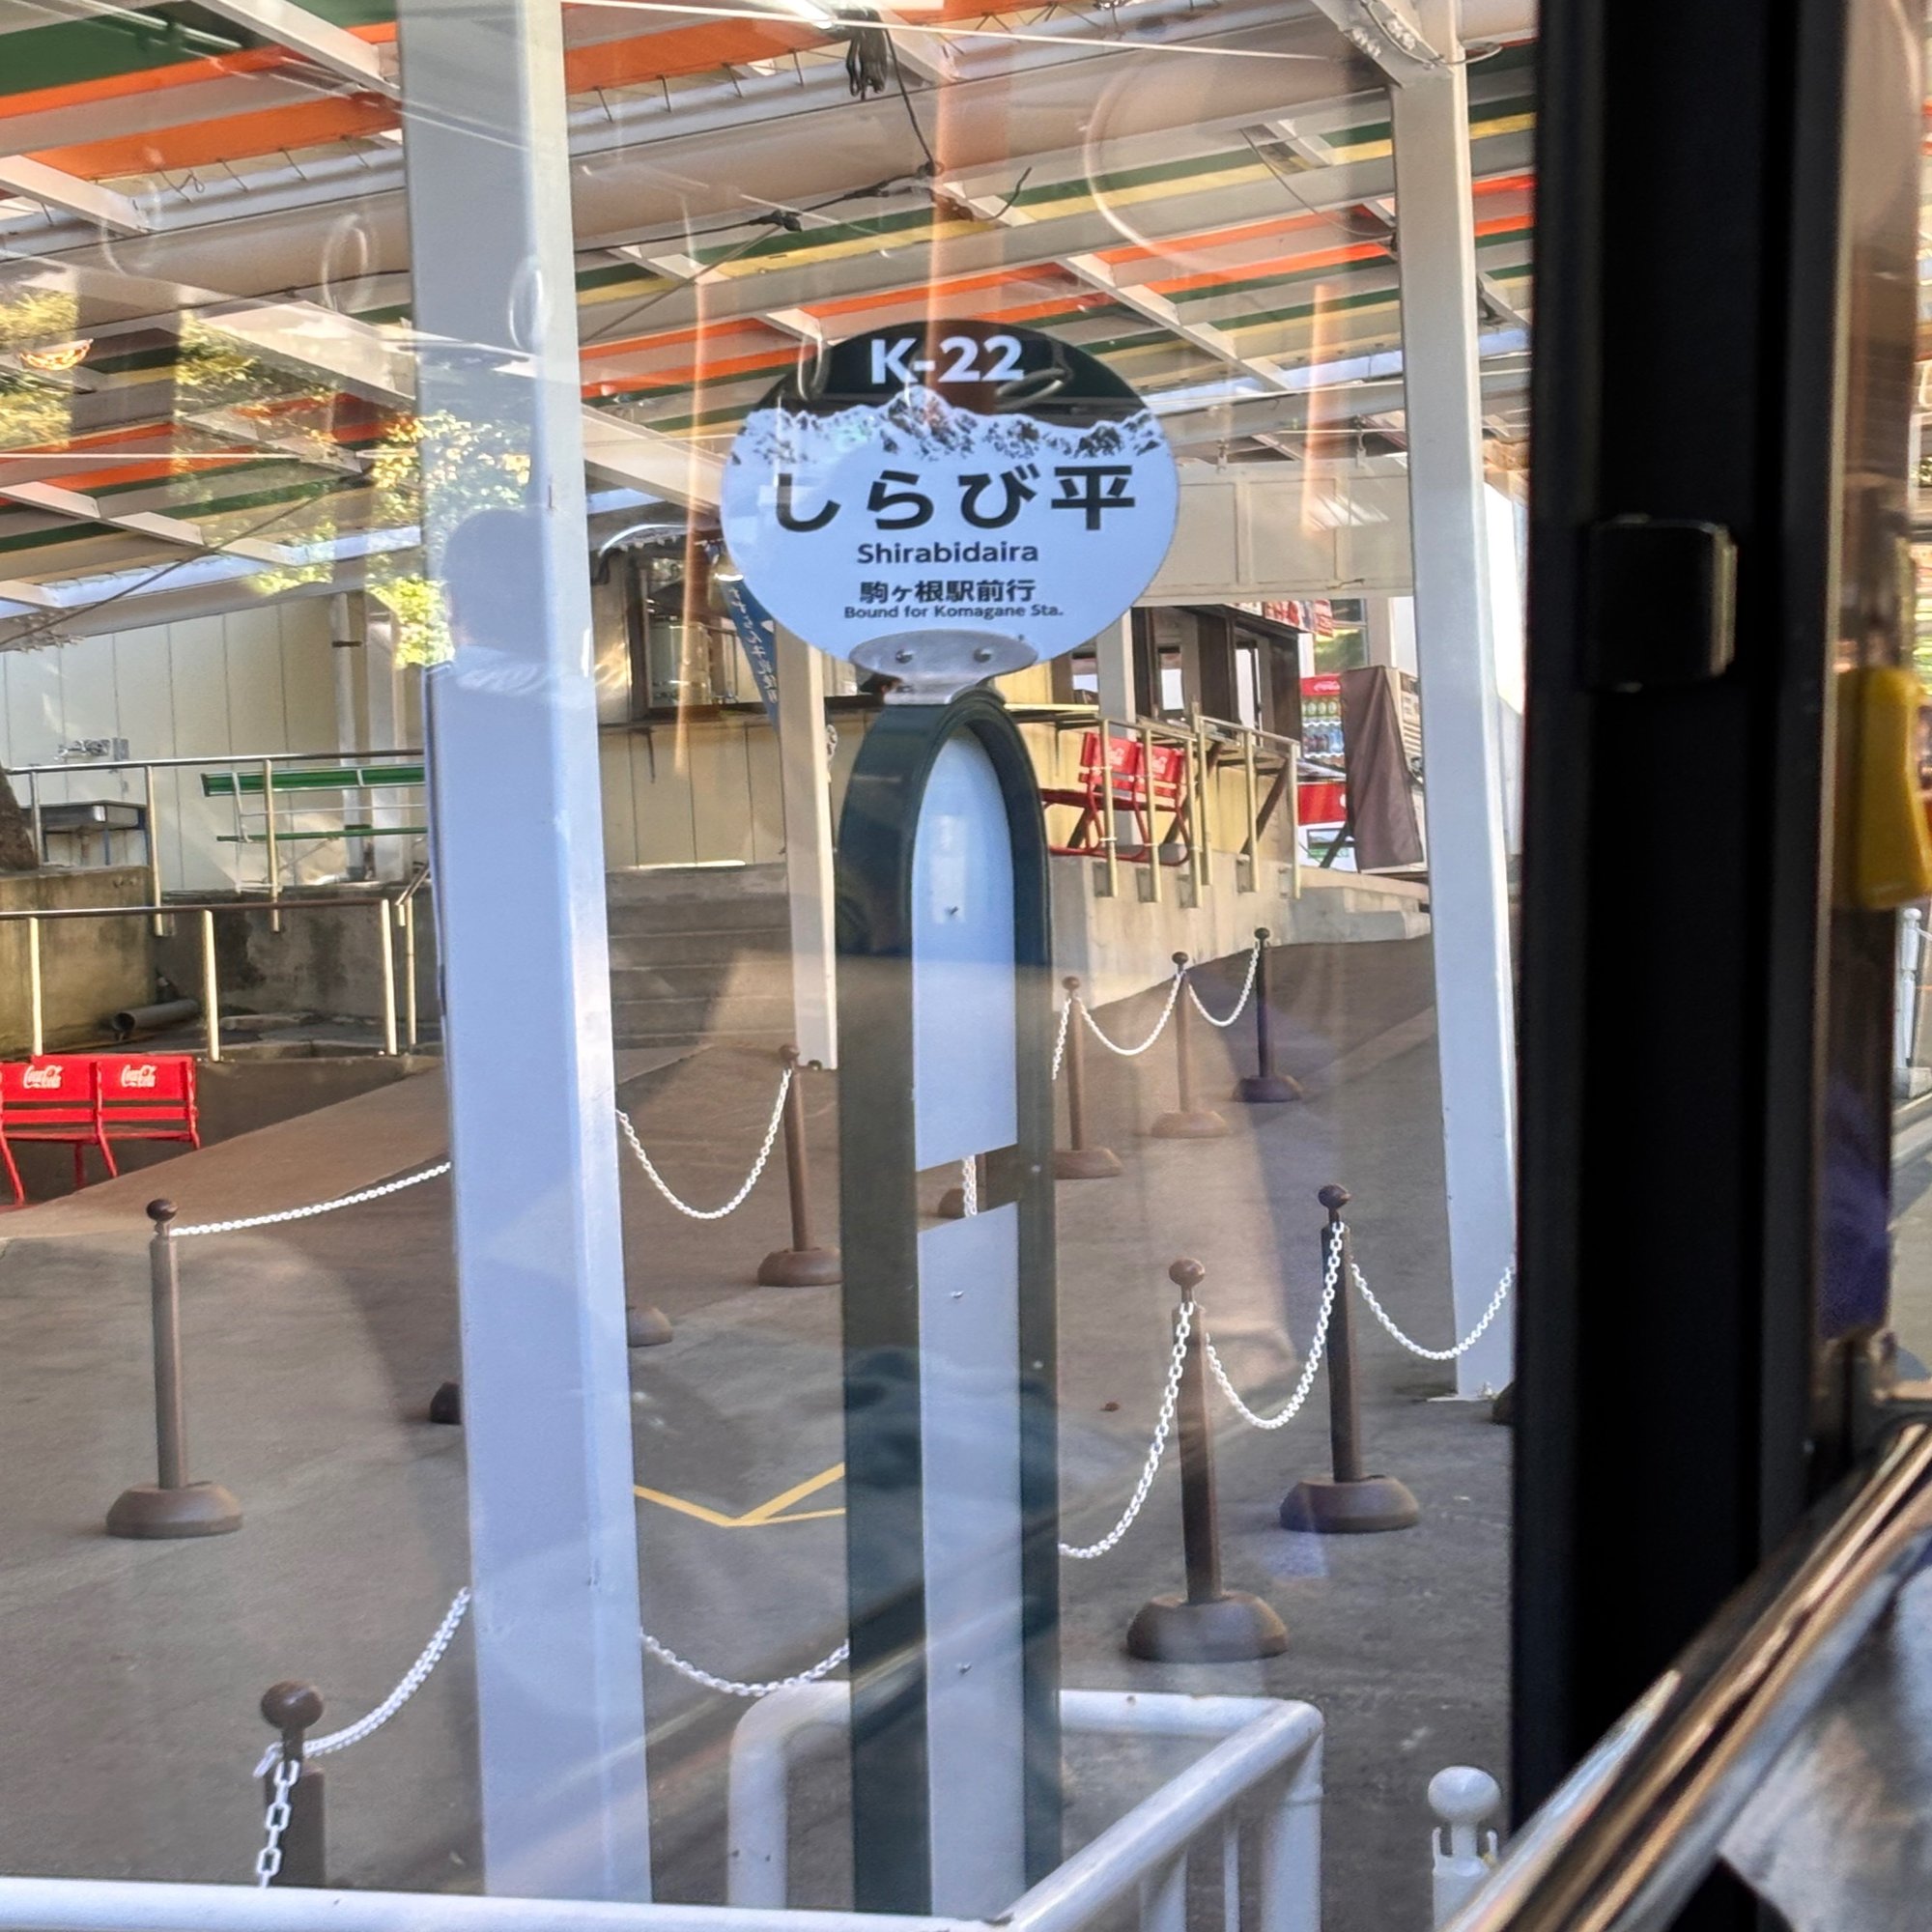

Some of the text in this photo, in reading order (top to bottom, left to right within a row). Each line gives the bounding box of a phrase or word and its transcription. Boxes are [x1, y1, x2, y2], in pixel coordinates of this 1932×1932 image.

[870, 336, 1024, 384] K-22
[775, 465, 1135, 532] しらび平
[857, 541, 1038, 563] Shirabidaira
[844, 603, 1065, 620] Bound for Komagane Sta.
